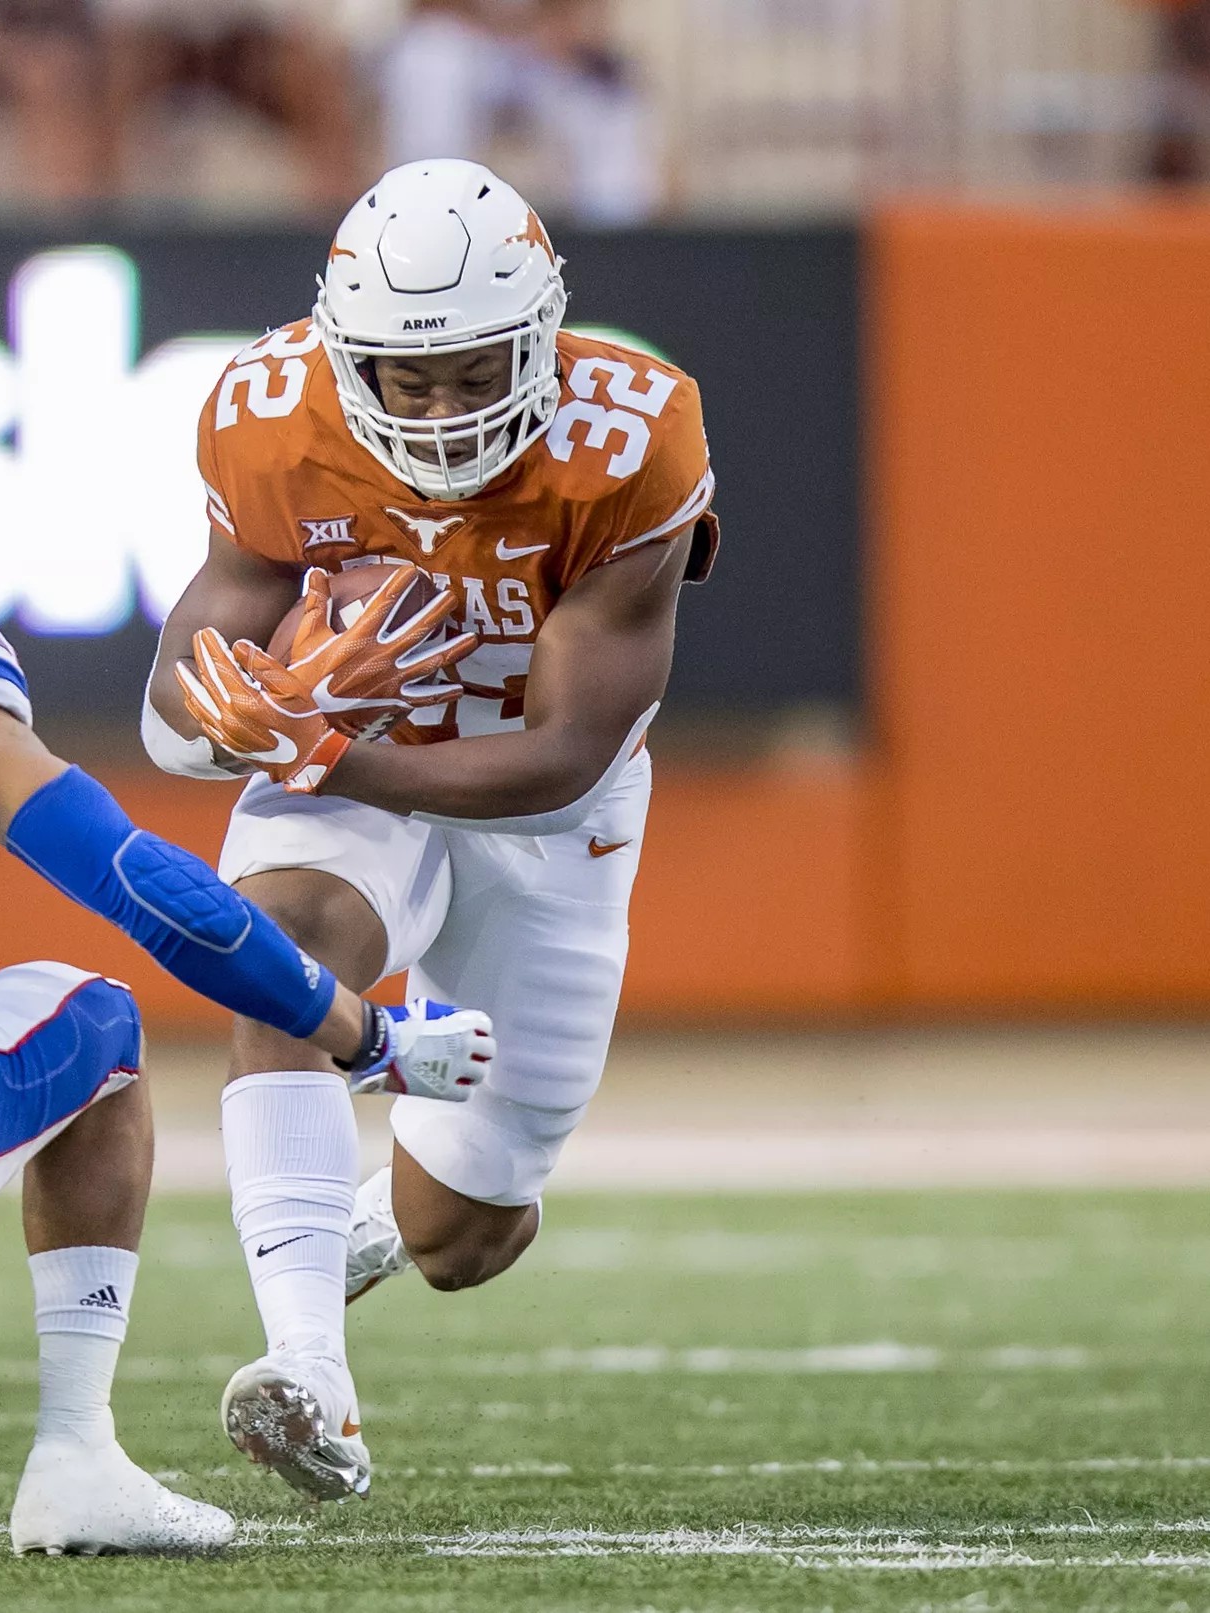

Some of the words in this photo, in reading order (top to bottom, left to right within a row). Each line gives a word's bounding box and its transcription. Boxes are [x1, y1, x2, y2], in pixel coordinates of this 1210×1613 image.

[402, 316, 447, 331] ARMY
[215, 323, 322, 432] 32
[545, 356, 678, 479] 32
[300, 517, 356, 547] XII
